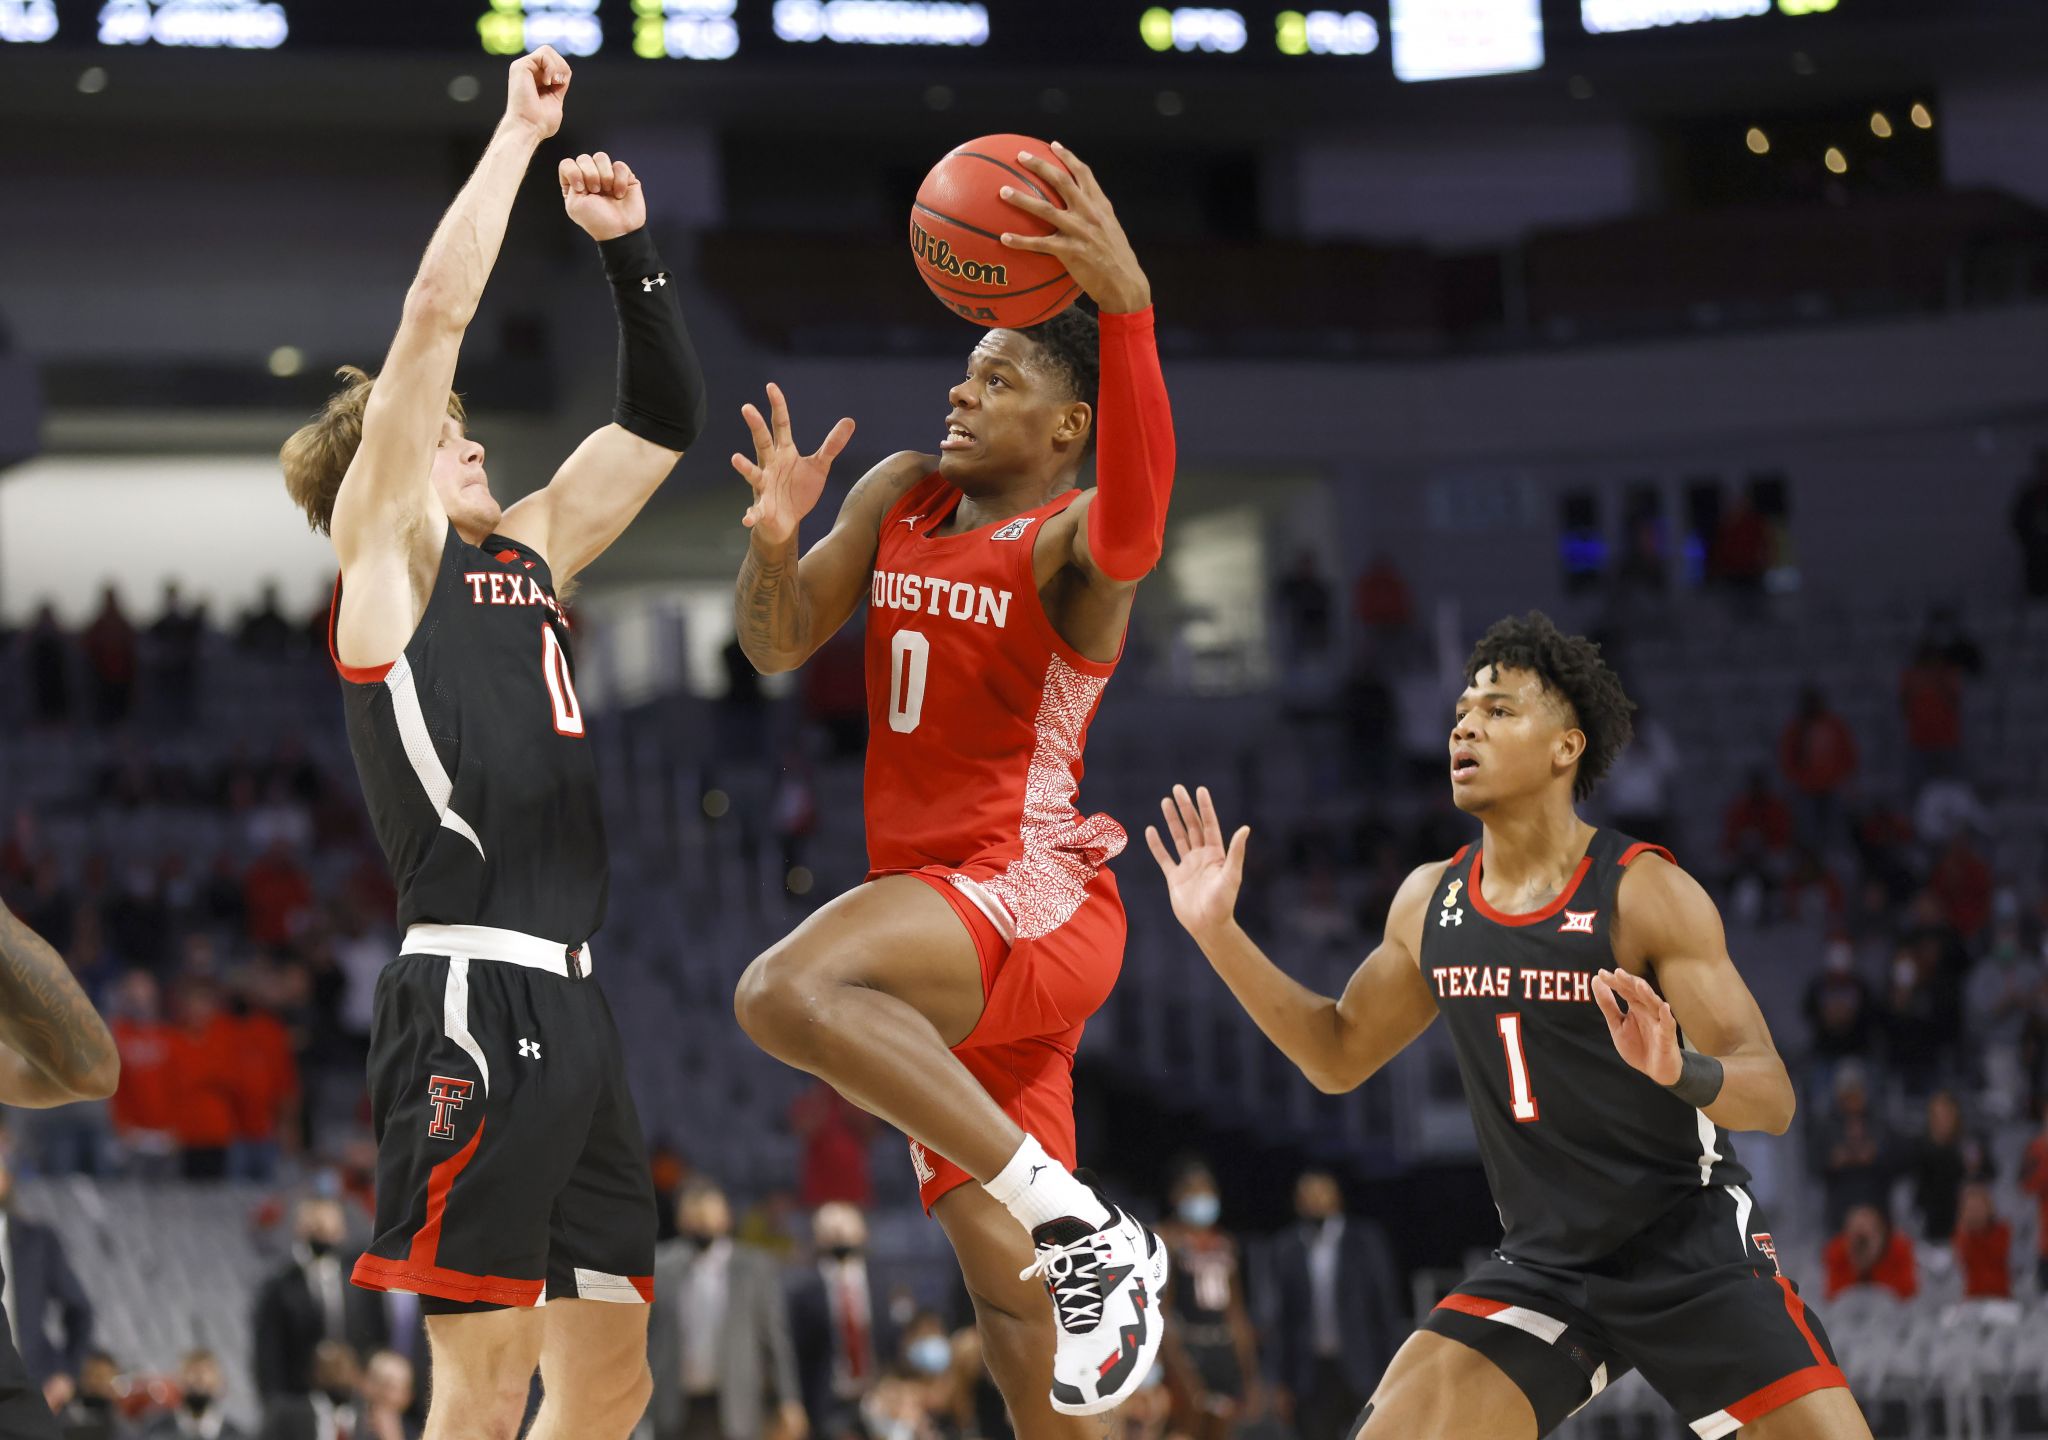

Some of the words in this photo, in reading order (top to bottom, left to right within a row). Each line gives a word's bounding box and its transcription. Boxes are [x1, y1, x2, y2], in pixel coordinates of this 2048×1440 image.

[911, 219, 1008, 286] Wilson
[541, 621, 585, 739] 0
[889, 629, 930, 734] 0
[1432, 966, 1512, 997] TEXAS
[1519, 968, 1594, 1002] TECH
[1496, 1012, 1539, 1123] 1
